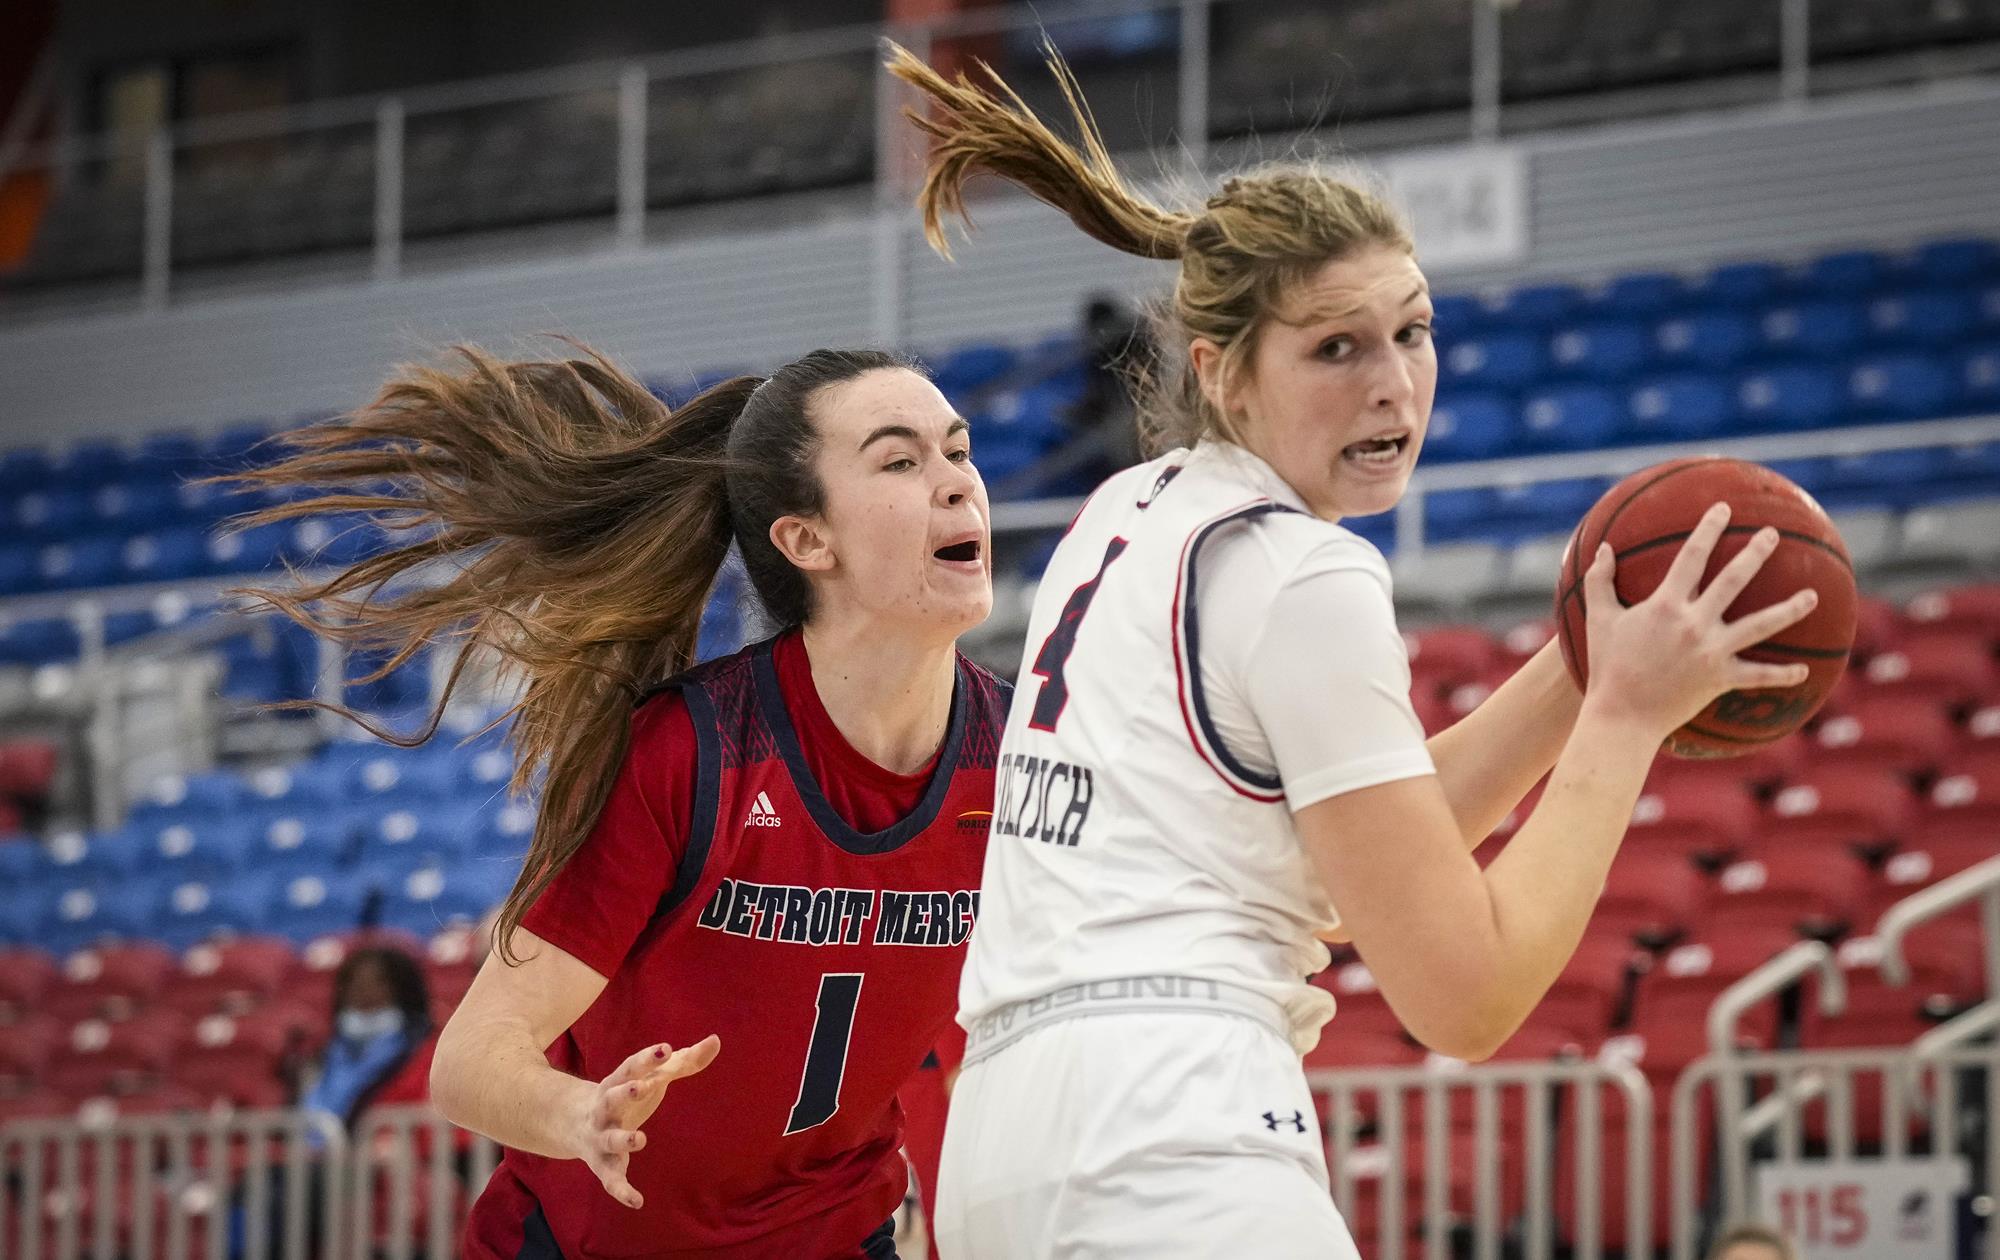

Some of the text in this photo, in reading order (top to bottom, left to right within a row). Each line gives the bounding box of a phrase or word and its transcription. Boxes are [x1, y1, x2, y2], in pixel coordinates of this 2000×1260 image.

[1028, 535, 1130, 734] 4
[697, 877, 876, 947] DETROIT
[783, 972, 866, 1136] 1
[1777, 1183, 1869, 1249] 115
